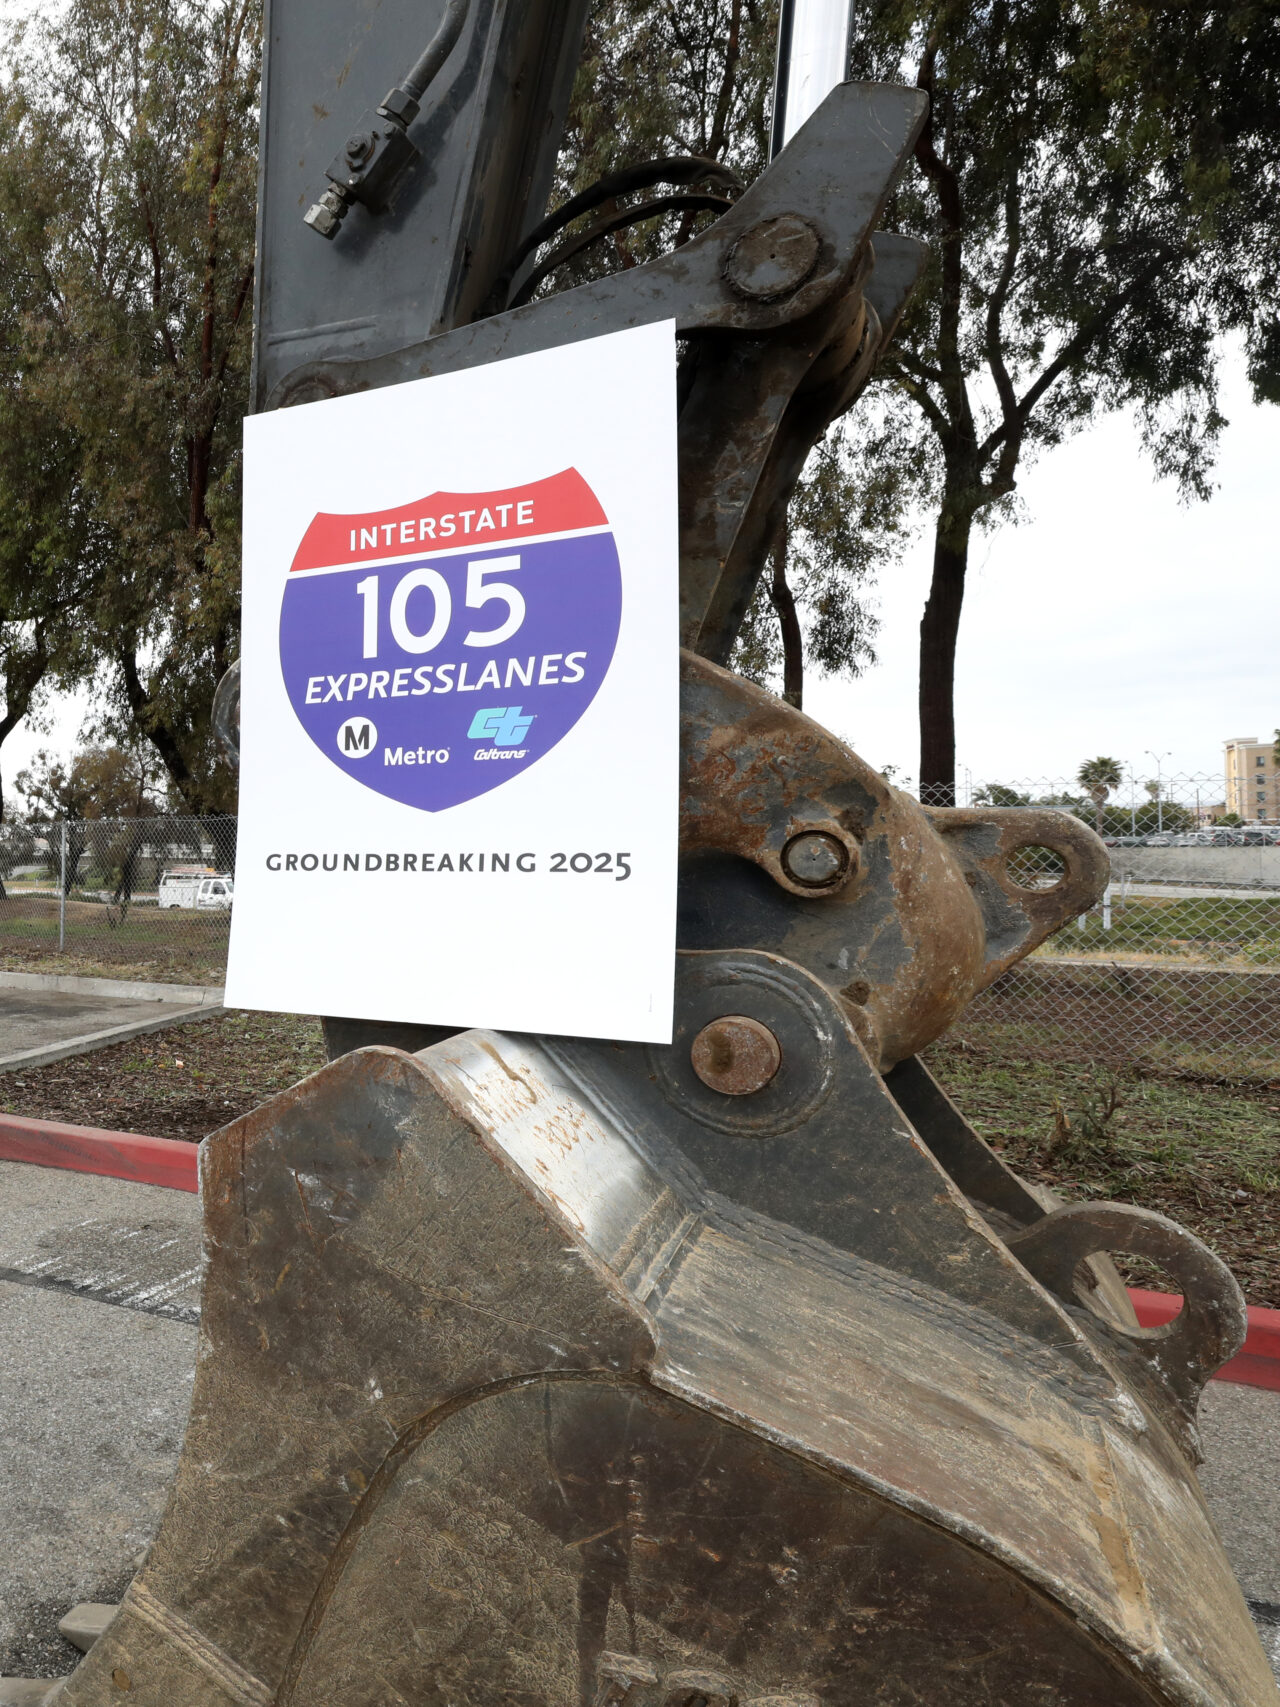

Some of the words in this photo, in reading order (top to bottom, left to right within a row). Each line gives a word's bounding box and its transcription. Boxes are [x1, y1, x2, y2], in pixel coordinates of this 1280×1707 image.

[350, 500, 534, 551] INTERSTATE
[356, 554, 526, 659] 105
[305, 651, 587, 704] EXPRESSLANES
[344, 724, 370, 751] M
[384, 747, 450, 766] Metro
[473, 748, 527, 761] Caltrans
[265, 852, 536, 873] GROUNDBREAKING
[549, 852, 631, 882] 2025
